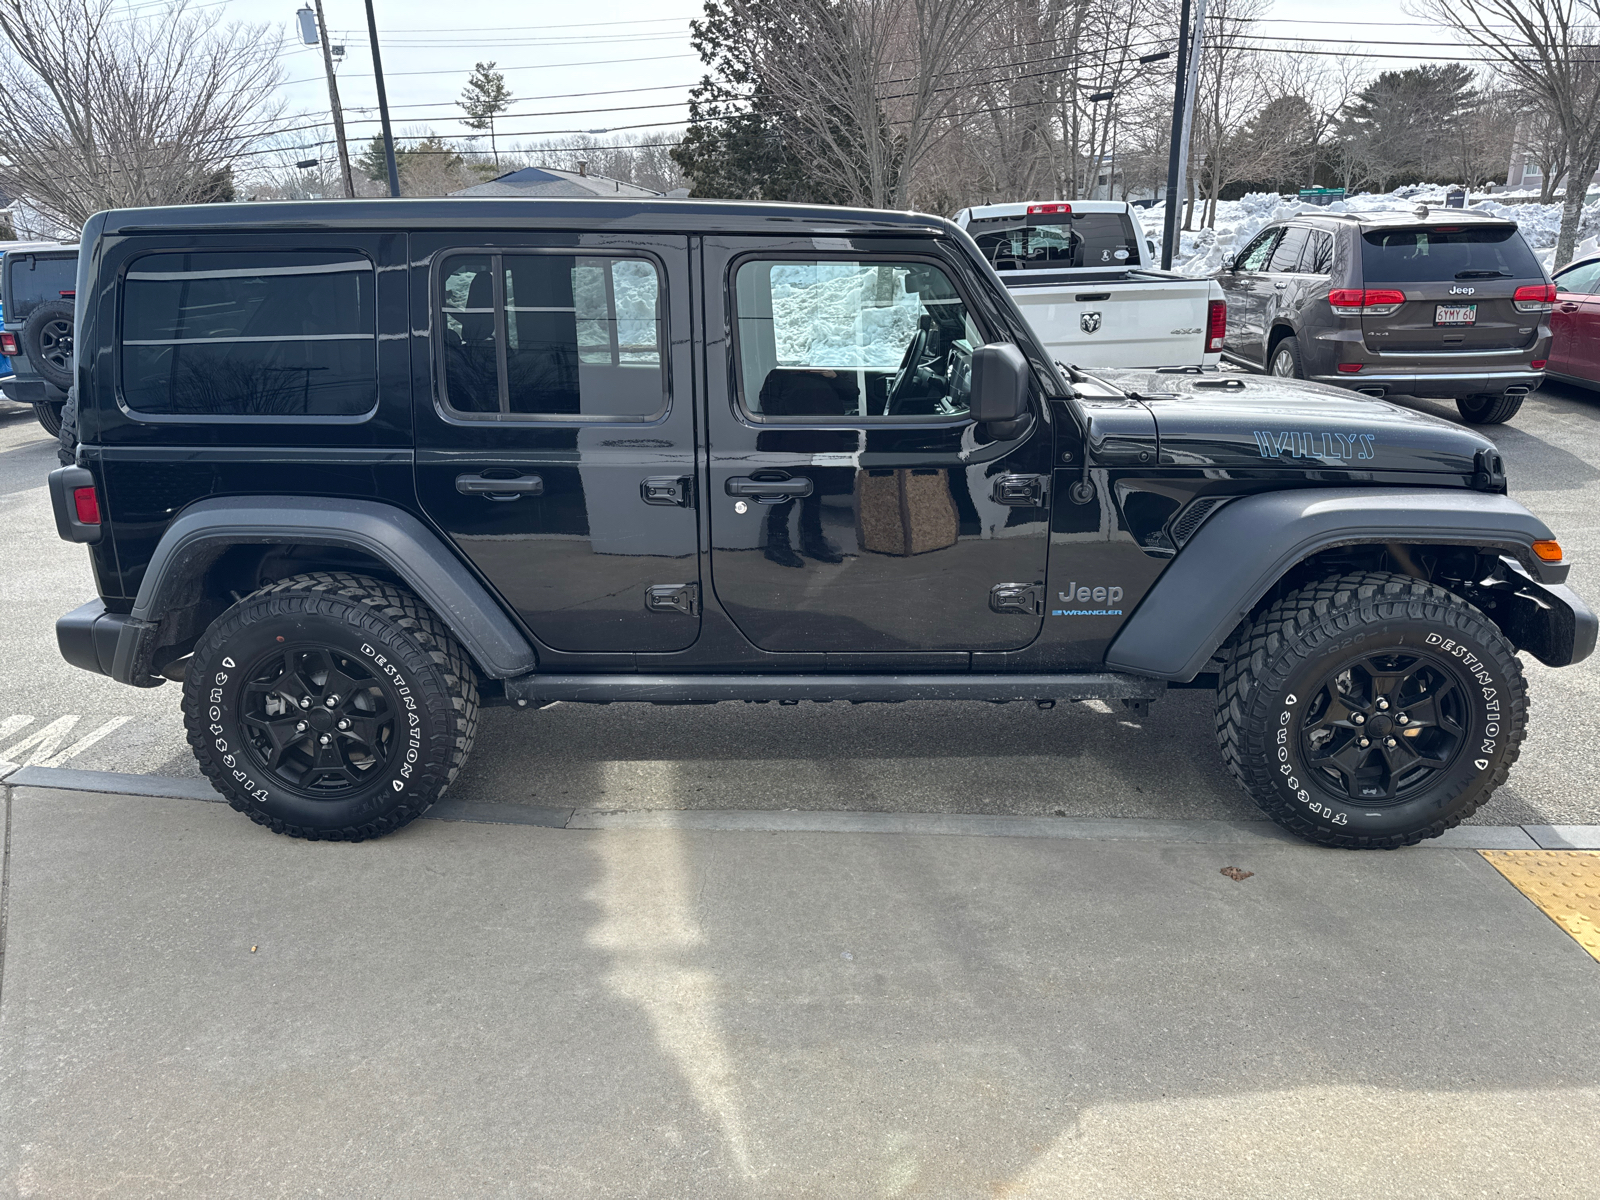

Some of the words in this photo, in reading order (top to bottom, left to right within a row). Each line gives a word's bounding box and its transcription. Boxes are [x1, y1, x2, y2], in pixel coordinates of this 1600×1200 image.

[1437, 309, 1460, 321] 6YMY
[1462, 309, 1475, 320] 60
[1449, 285, 1475, 296] Jeep
[1253, 430, 1376, 460] WILLYS
[1058, 581, 1124, 606] Jeep
[360, 643, 421, 779] DESTINATION
[1425, 632, 1500, 754] DESTINATION
[209, 671, 270, 802] Firestone
[1276, 710, 1348, 826] Firestone
